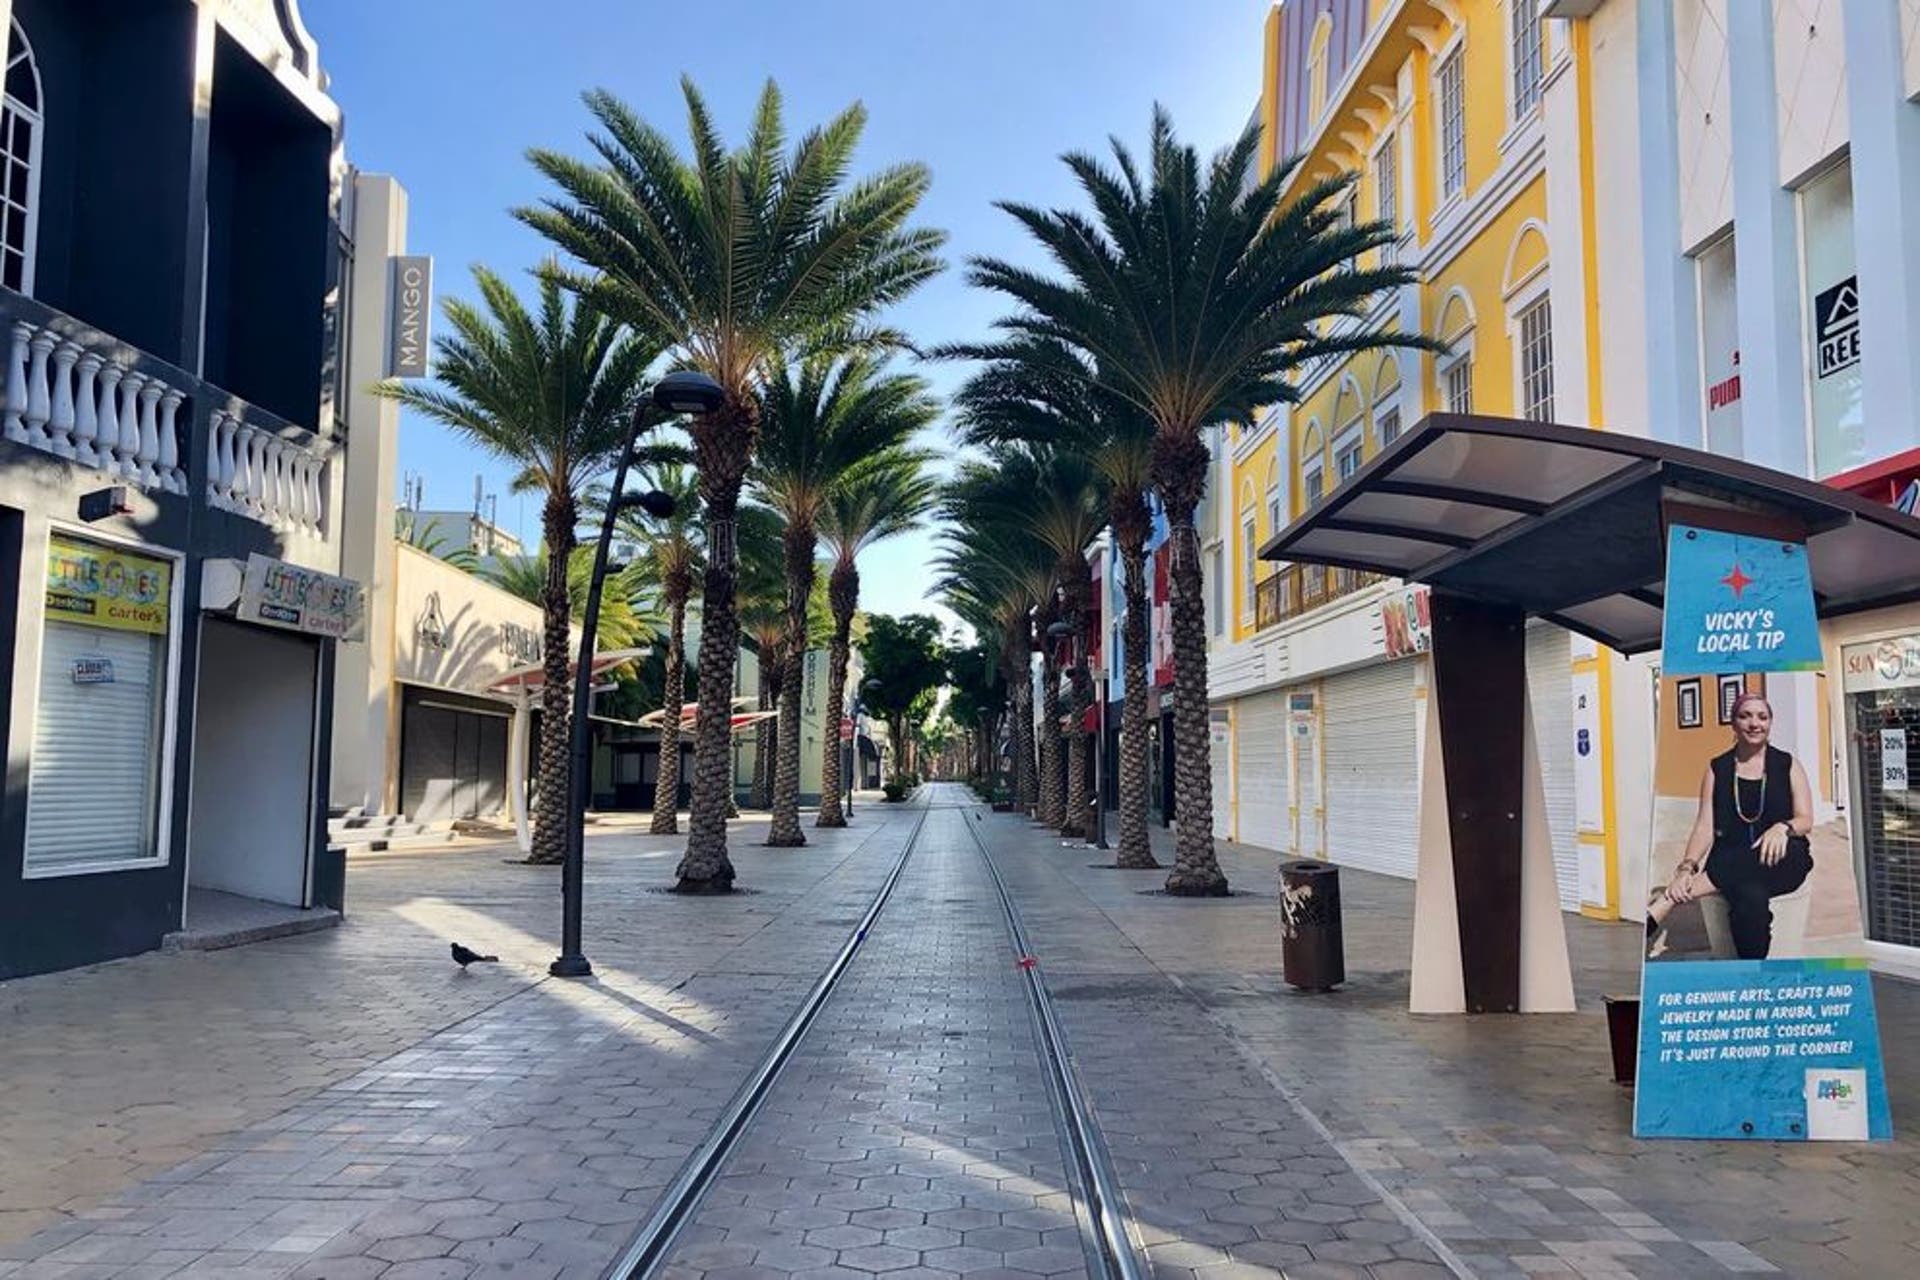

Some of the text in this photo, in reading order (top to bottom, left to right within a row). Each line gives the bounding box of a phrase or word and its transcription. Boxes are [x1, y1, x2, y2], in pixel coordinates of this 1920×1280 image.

[402, 267, 421, 366] MANGO
[108, 605, 163, 624] carter's
[1705, 608, 1774, 631] VICKY'S
[1697, 629, 1785, 653] LOCAL TIP
[1848, 654, 1875, 674] SUN
[1885, 766, 1905, 780] 30%
[1659, 992, 1682, 1006] FOR
[1684, 990, 1736, 1005] GENUINE
[1777, 986, 1823, 1000] CRAFTS
[1826, 984, 1853, 998] AND
[1660, 1003, 1852, 1025] JEWELRY MADE IN ARUBA, VISIT
[1661, 1030, 1683, 1044] THE
[1686, 1028, 1730, 1043] DESIGN
[1732, 1025, 1770, 1040] STORE
[1660, 1040, 1853, 1063] IT'S JUST AROUND THE CORNER!
